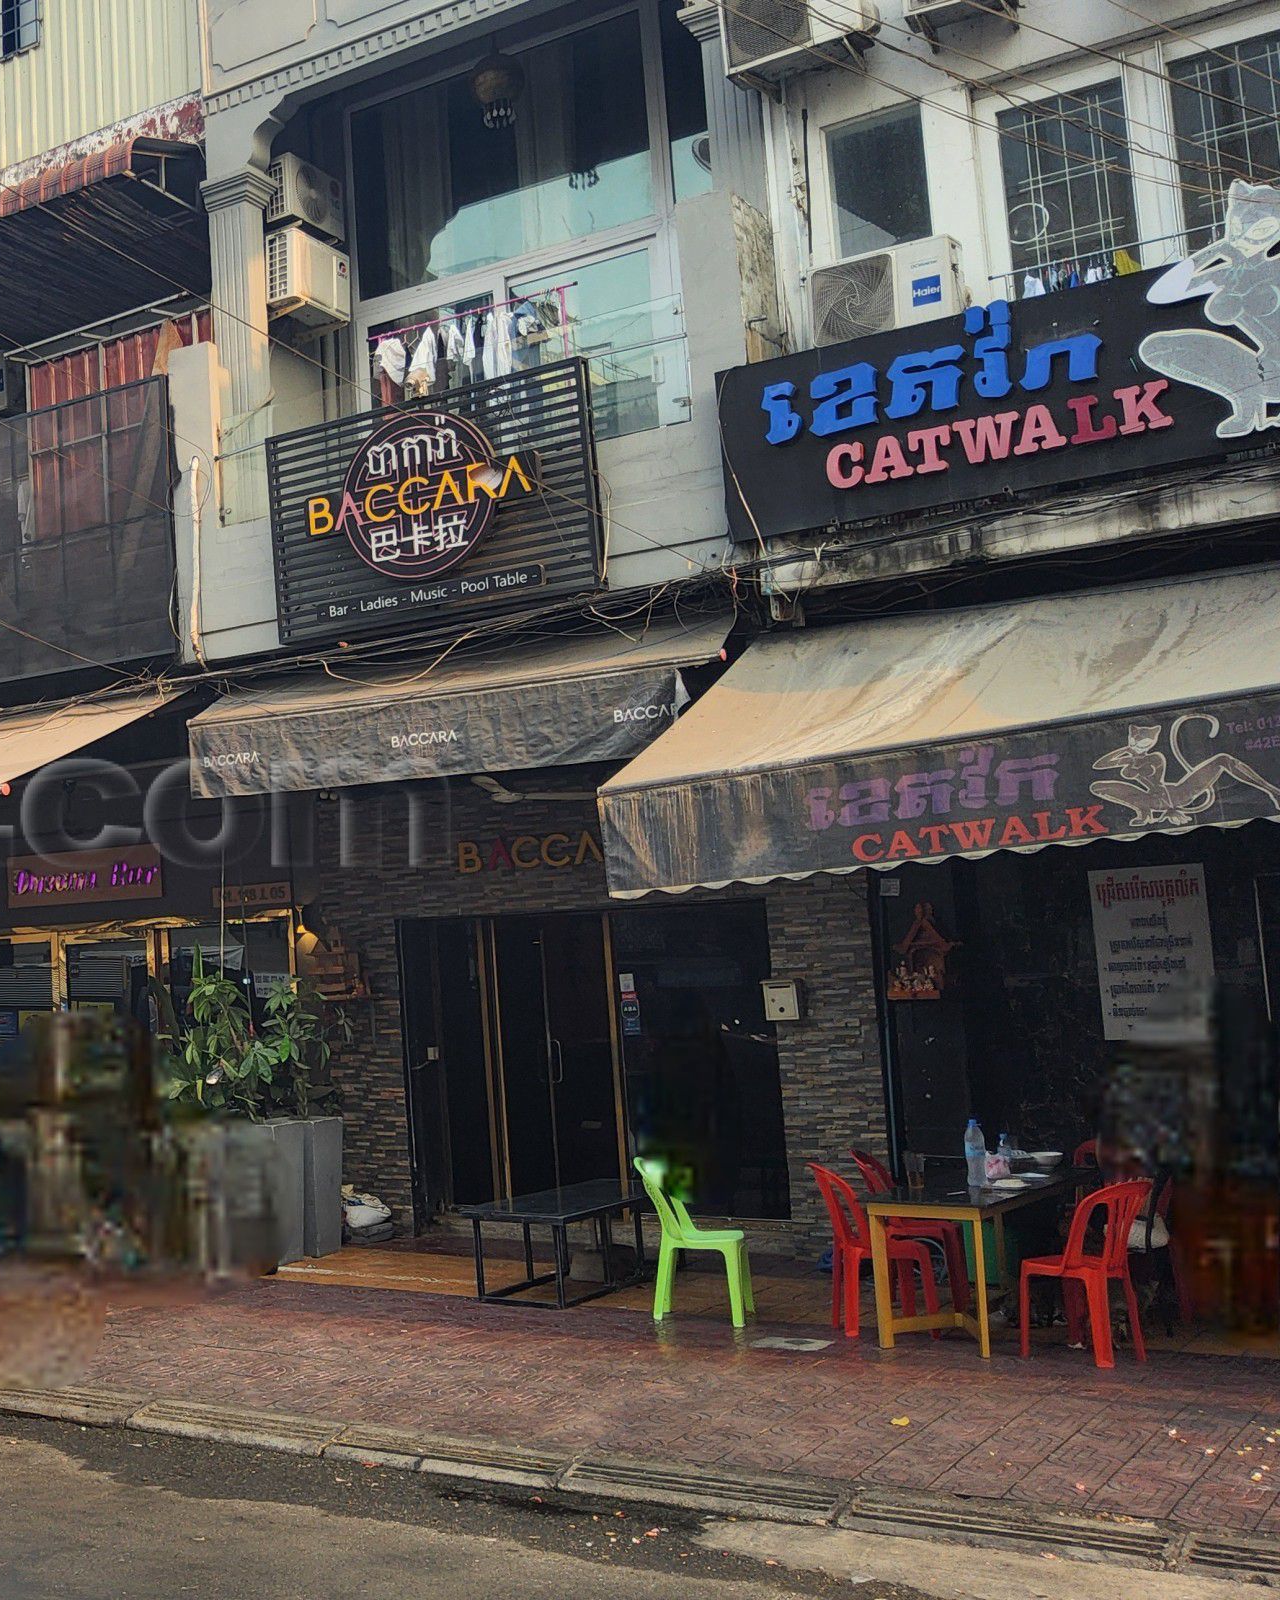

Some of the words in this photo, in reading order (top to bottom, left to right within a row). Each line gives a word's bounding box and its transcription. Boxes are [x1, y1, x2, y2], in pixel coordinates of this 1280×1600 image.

[913, 286, 941, 298] Haier
[825, 379, 1175, 489] CATWALK
[308, 455, 532, 536] BACCARA
[371, 515, 469, 563] 巴卡拉
[329, 605, 349, 618] Bar
[360, 596, 398, 612] Ladies
[411, 586, 448, 603] Music
[461, 577, 489, 594] Pool
[493, 572, 528, 588] Table
[203, 751, 260, 768] BACCARA
[391, 729, 458, 748] BACCARA
[852, 804, 1109, 862] CATWALK
[111, 863, 158, 887] Bar
